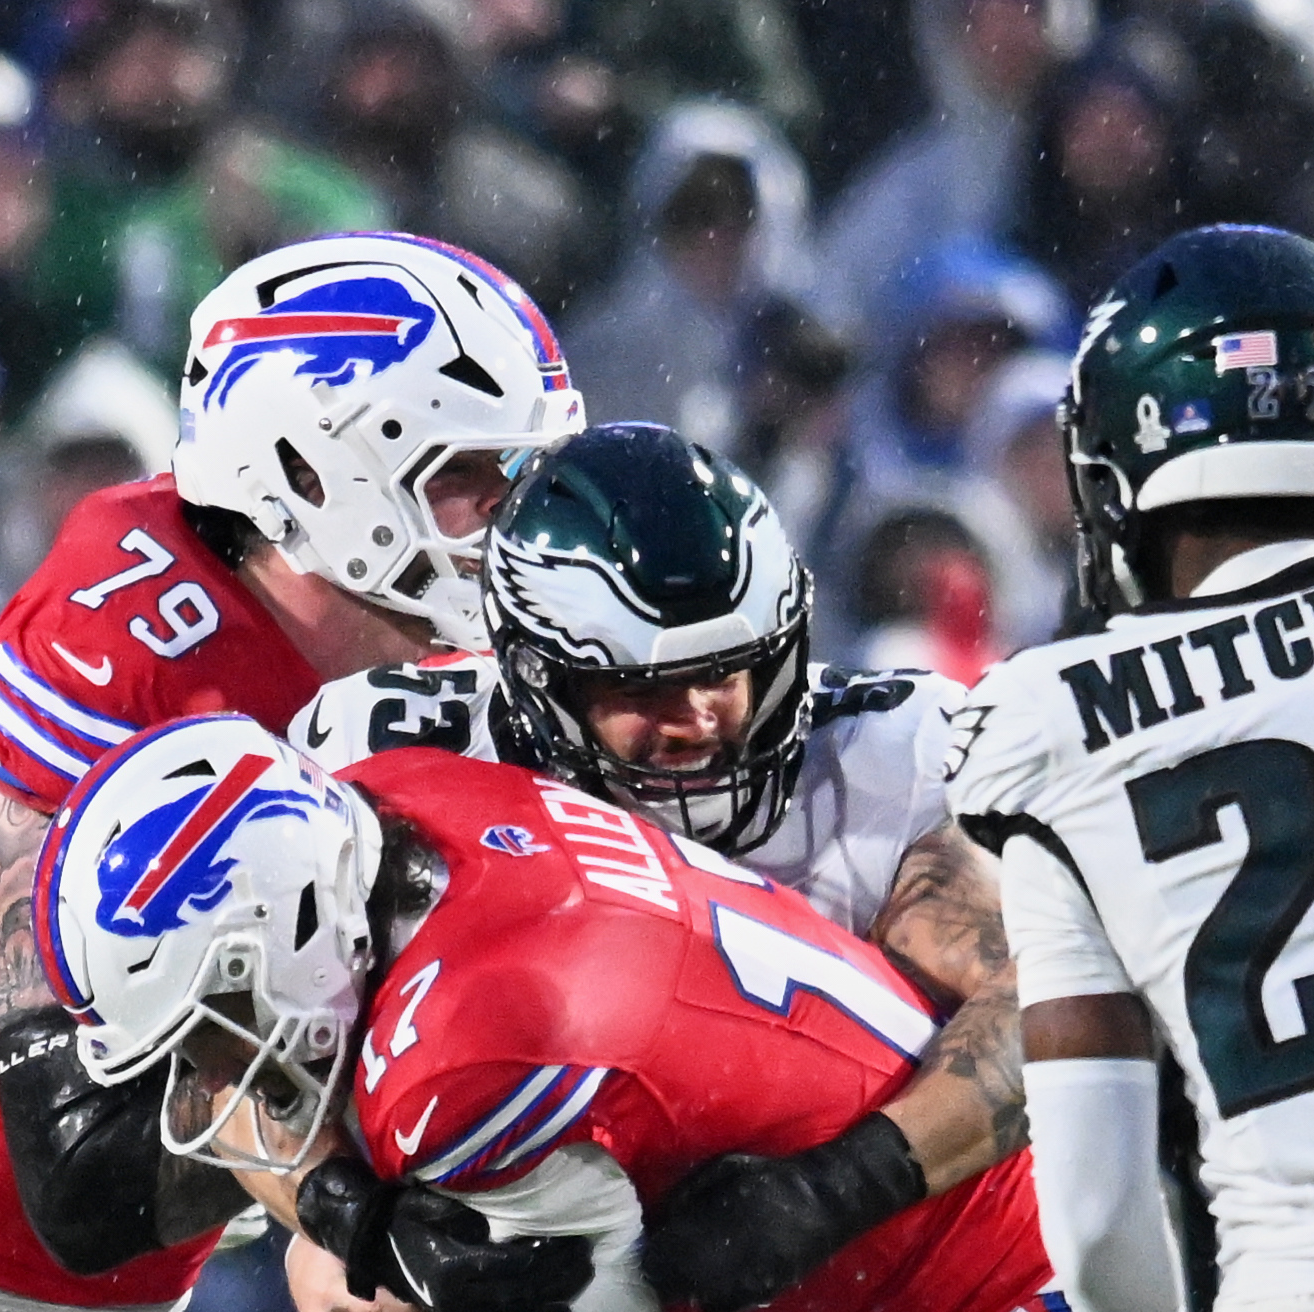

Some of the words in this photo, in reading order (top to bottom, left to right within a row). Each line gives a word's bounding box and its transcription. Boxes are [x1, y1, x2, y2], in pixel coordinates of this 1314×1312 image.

[67, 526, 222, 661] 79
[367, 663, 477, 755] 53
[360, 957, 443, 1096] 17
